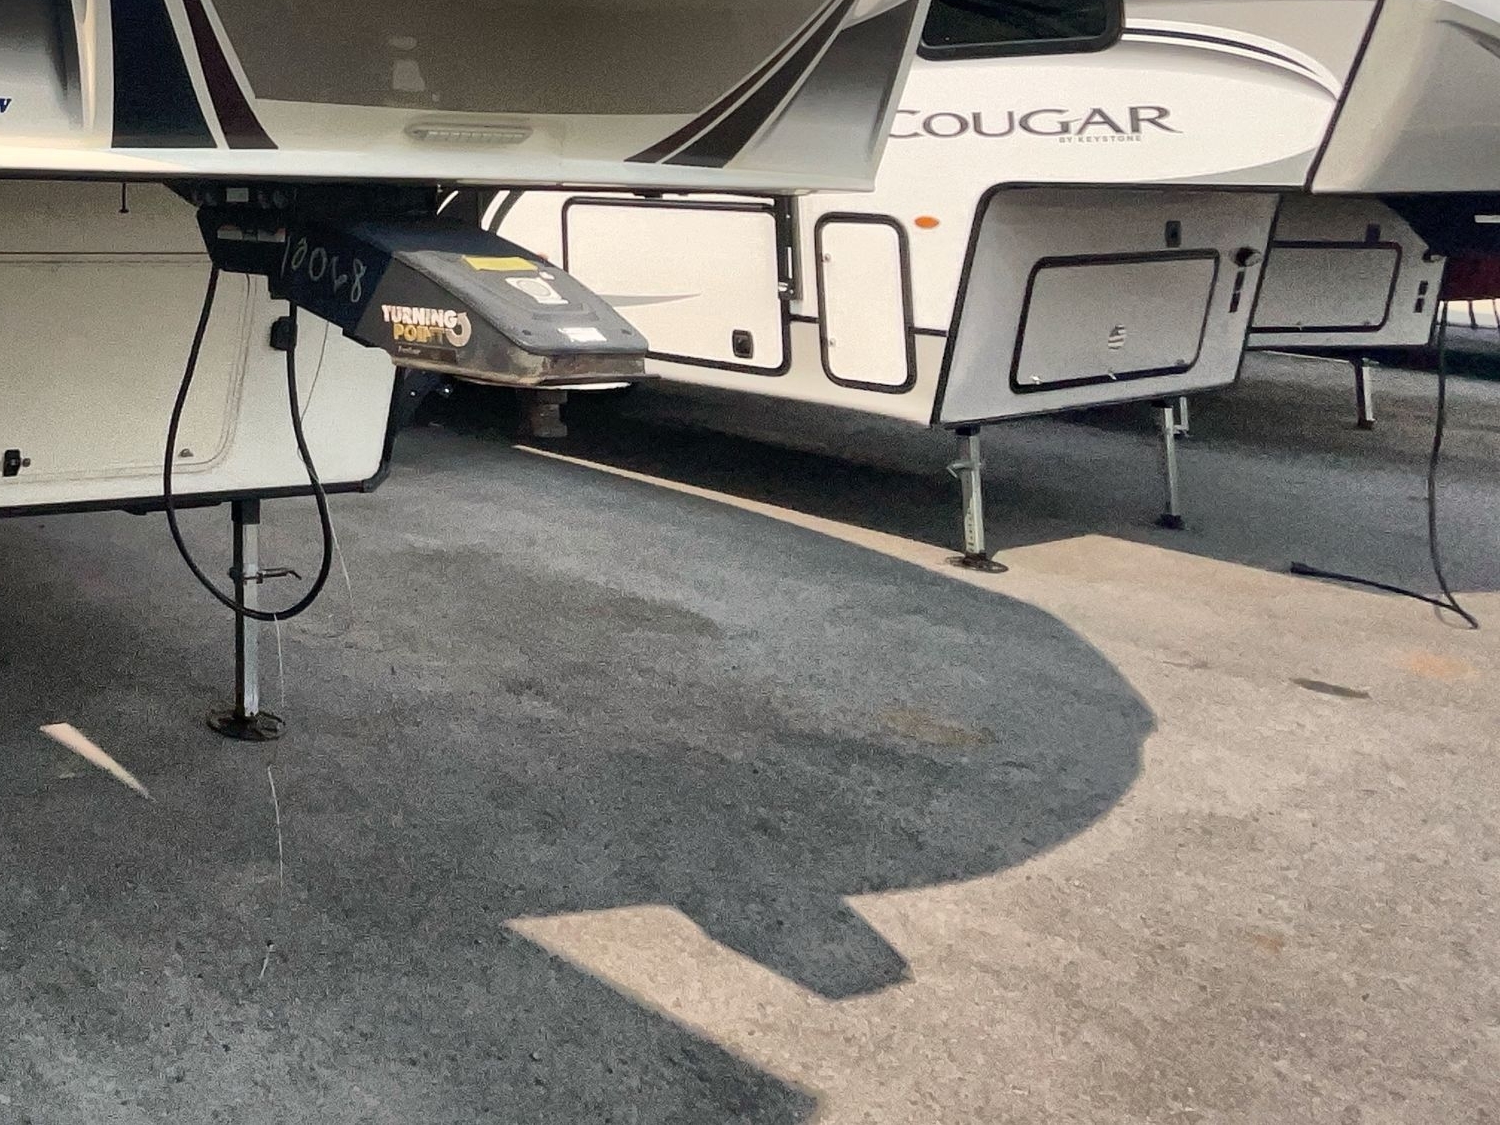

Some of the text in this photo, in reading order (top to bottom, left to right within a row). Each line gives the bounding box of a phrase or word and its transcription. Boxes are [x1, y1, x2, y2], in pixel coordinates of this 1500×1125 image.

[889, 106, 1183, 138] COUGAR
[1058, 135, 1142, 143] BY KEYSTONE
[381, 305, 458, 329] TURNING
